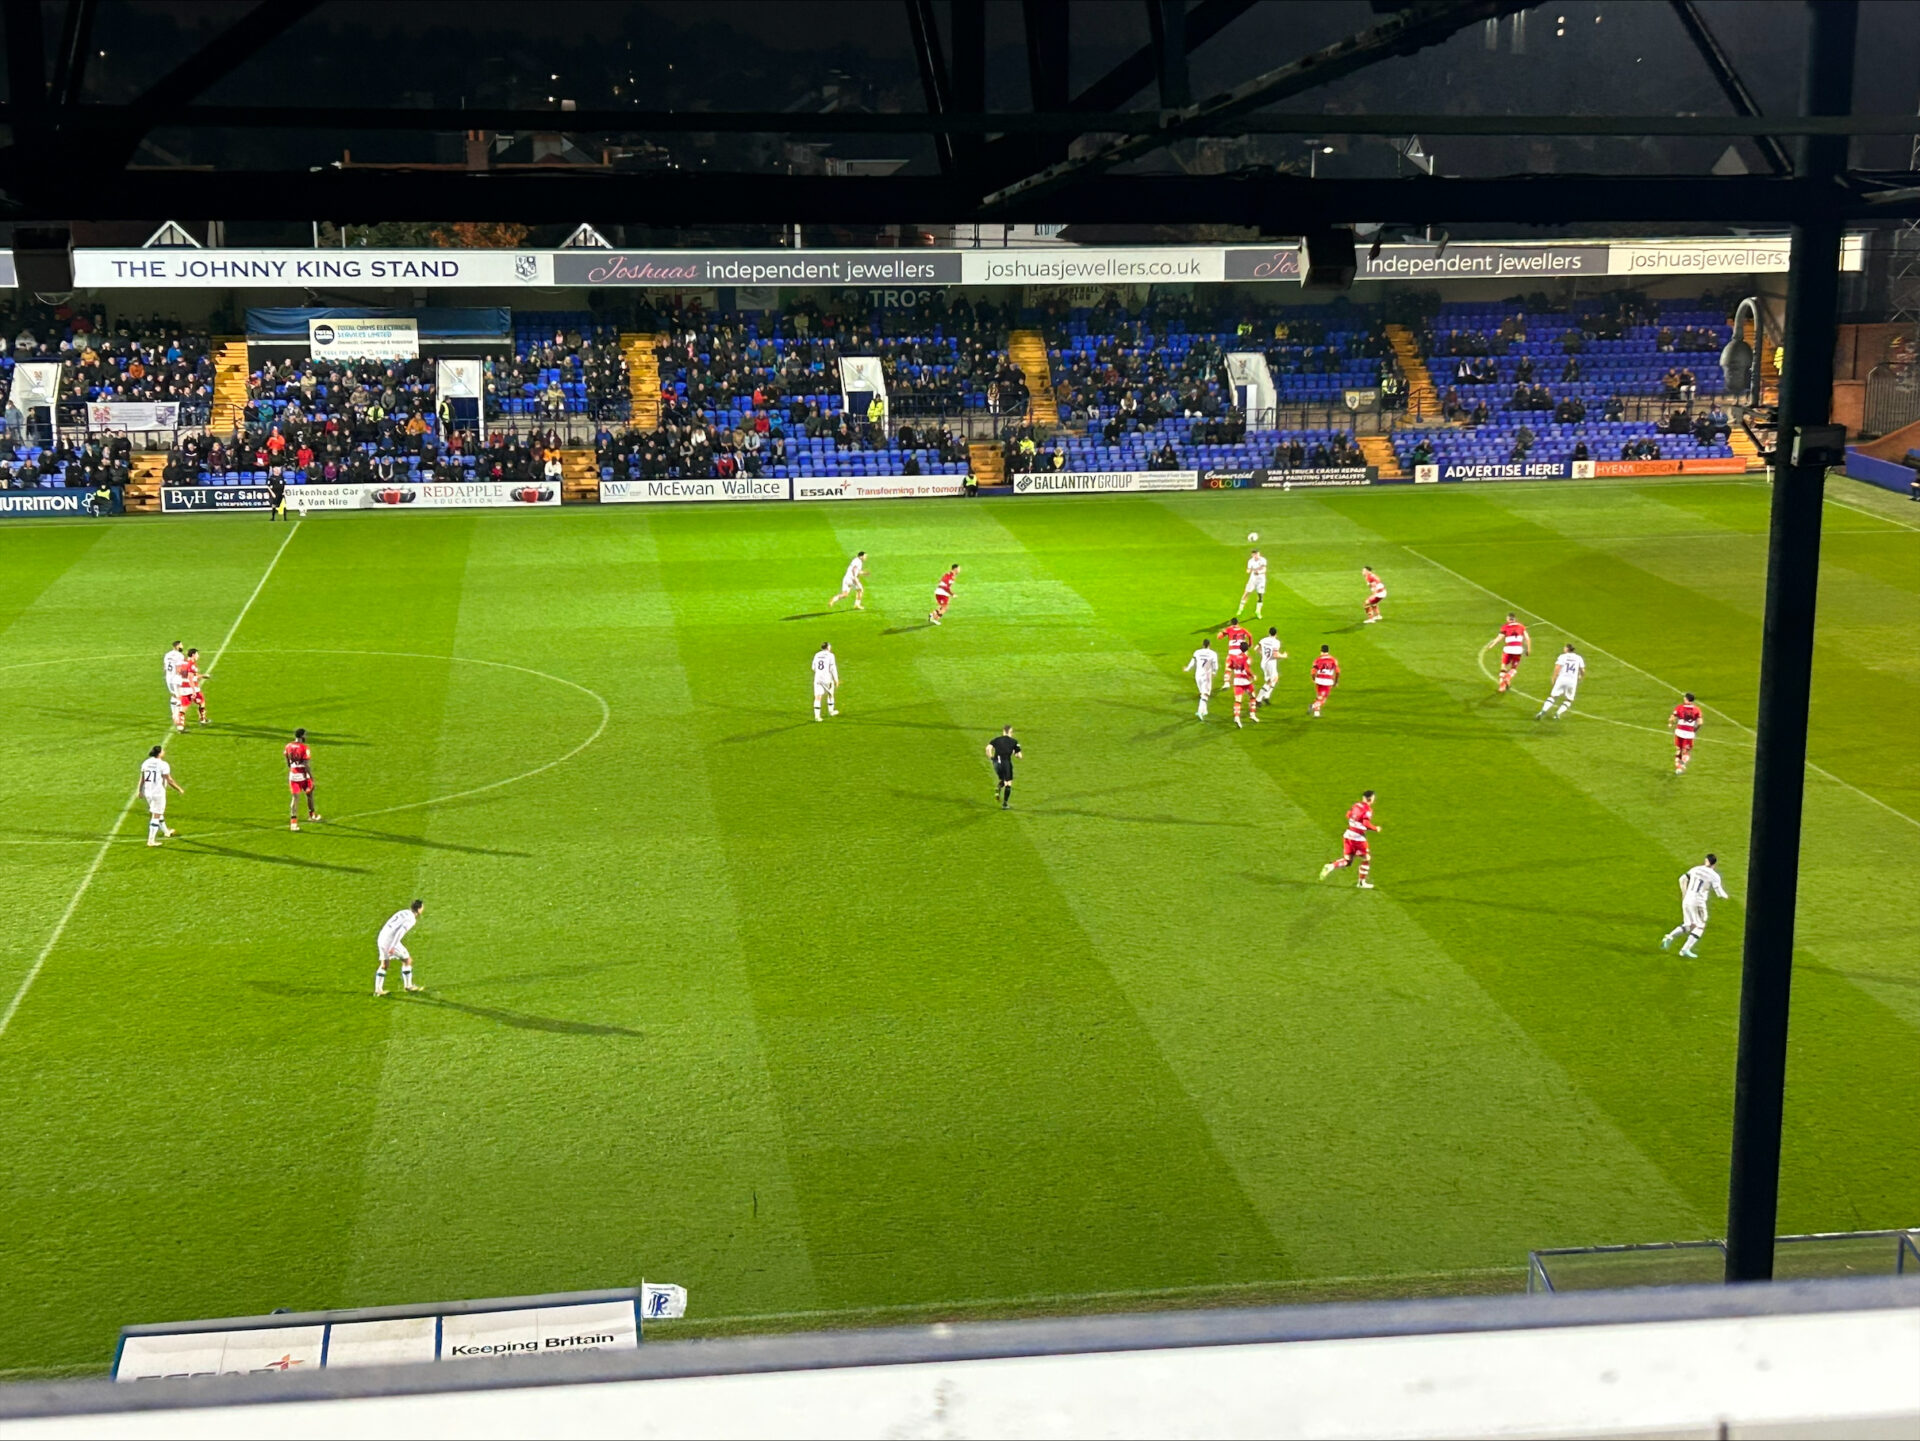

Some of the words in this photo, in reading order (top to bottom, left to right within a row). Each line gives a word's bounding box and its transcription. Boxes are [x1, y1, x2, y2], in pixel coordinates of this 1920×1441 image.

[1366, 254, 1492, 276] independent
[1495, 252, 1582, 275] jewellers
[1628, 250, 1787, 271] joshuasjewellers.
[111, 260, 167, 278] THE
[175, 260, 288, 278] JOHNNY
[297, 260, 362, 278] KING
[371, 260, 459, 278] STAND
[588, 256, 699, 283] Joshuas
[706, 261, 840, 282] independent
[844, 260, 936, 282] jewellers
[985, 258, 1201, 281] joshuasjewellers.co.uk
[1445, 464, 1522, 478] ADVERTISE
[1525, 463, 1565, 476] HERE!
[214, 491, 235, 500] Car
[238, 490, 270, 500] Sales
[285, 488, 340, 497] Birkenhead
[342, 488, 359, 496] Car
[647, 482, 715, 496] McEwan
[722, 480, 780, 495] Wallace
[800, 488, 844, 497] ESSAR
[856, 487, 915, 496] Transforming
[917, 486, 930, 494] for
[171, 490, 207, 509] BVH
[308, 498, 326, 506] Van
[328, 498, 348, 506] Hire
[433, 497, 493, 505] EDUCATION
[817, 660, 825, 670] 8
[1565, 663, 1576, 674] 14
[145, 770, 157, 783] 21
[452, 1340, 538, 1356] Keeping
[545, 1333, 614, 1348] Britain
